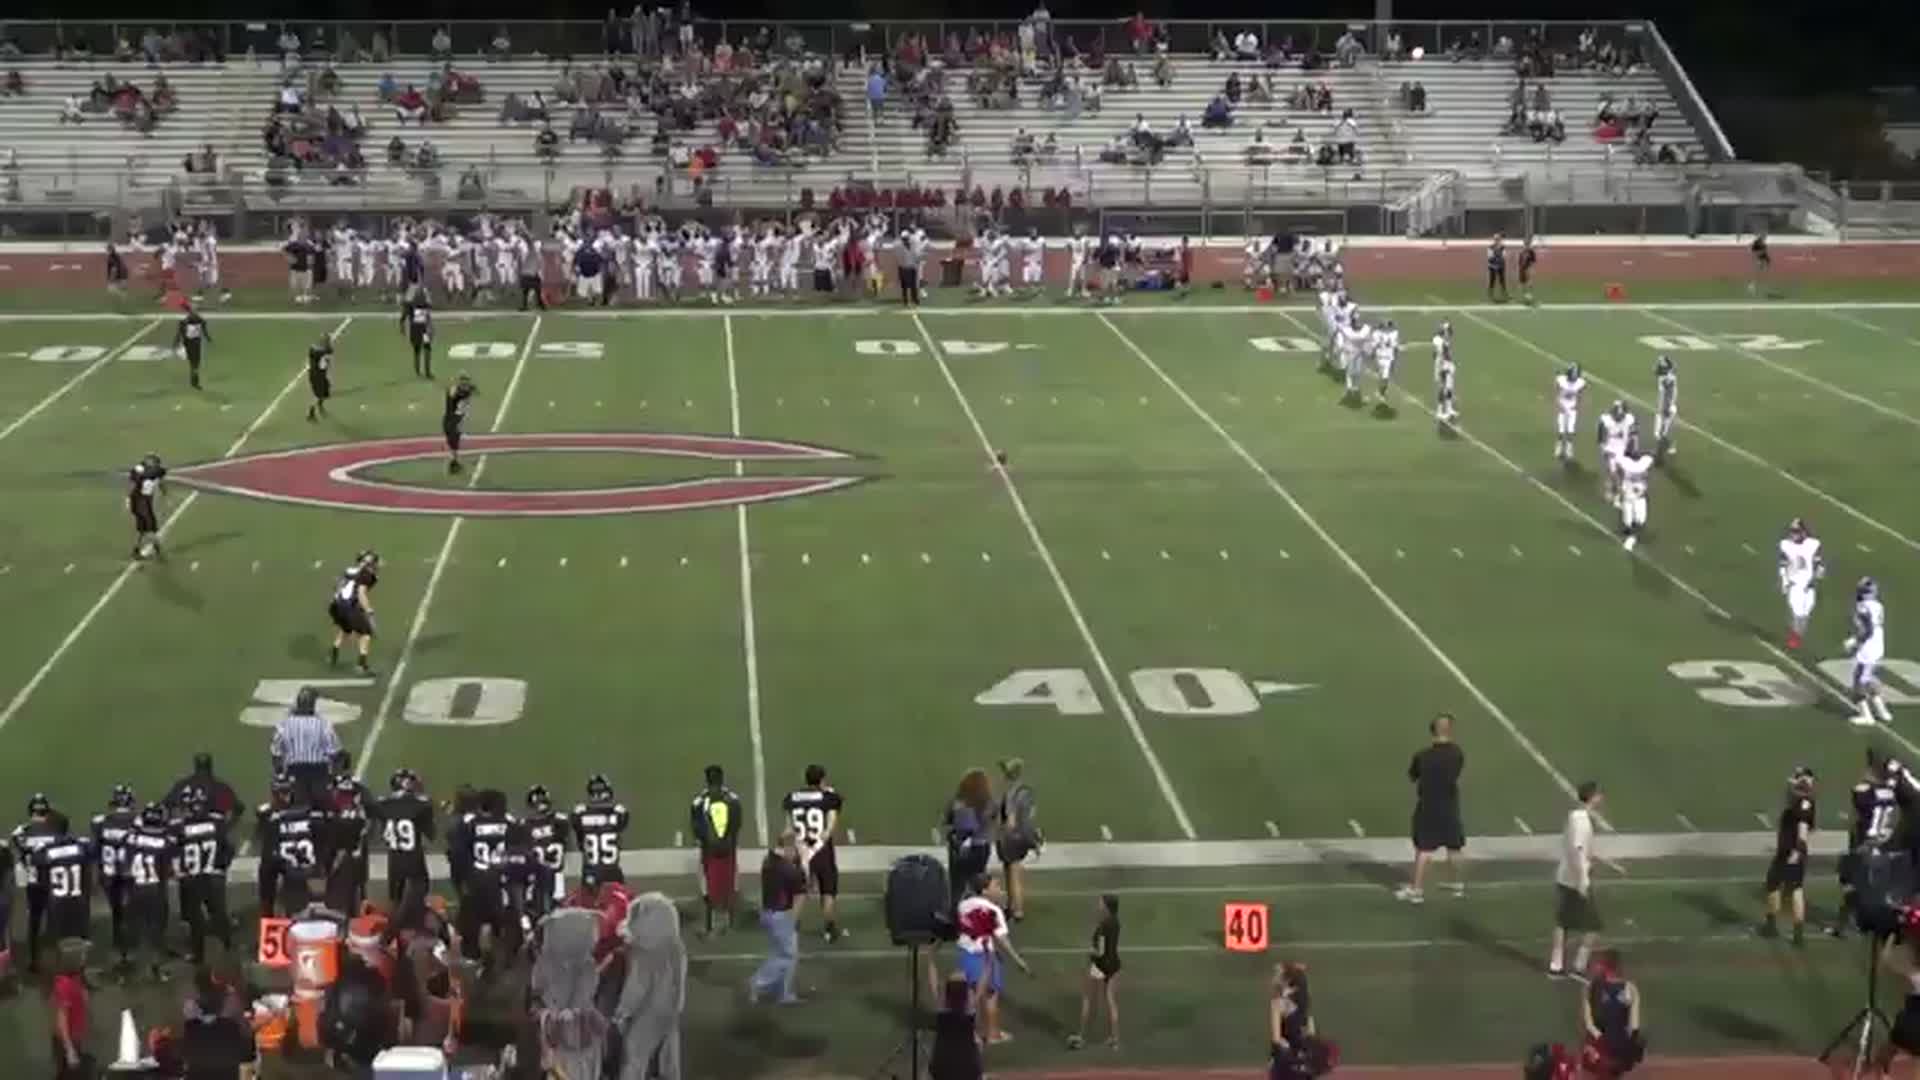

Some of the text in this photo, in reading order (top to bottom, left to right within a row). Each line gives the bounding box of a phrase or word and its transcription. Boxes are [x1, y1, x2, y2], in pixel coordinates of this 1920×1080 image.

[448, 341, 604, 358] 50
[855, 340, 1009, 355] 40
[239, 677, 528, 727] 50
[974, 668, 1261, 714] 40
[384, 819, 415, 851] 49
[792, 807, 824, 841] 59
[50, 864, 82, 897] 91
[131, 853, 160, 884] 41
[1228, 908, 1264, 946] 40
